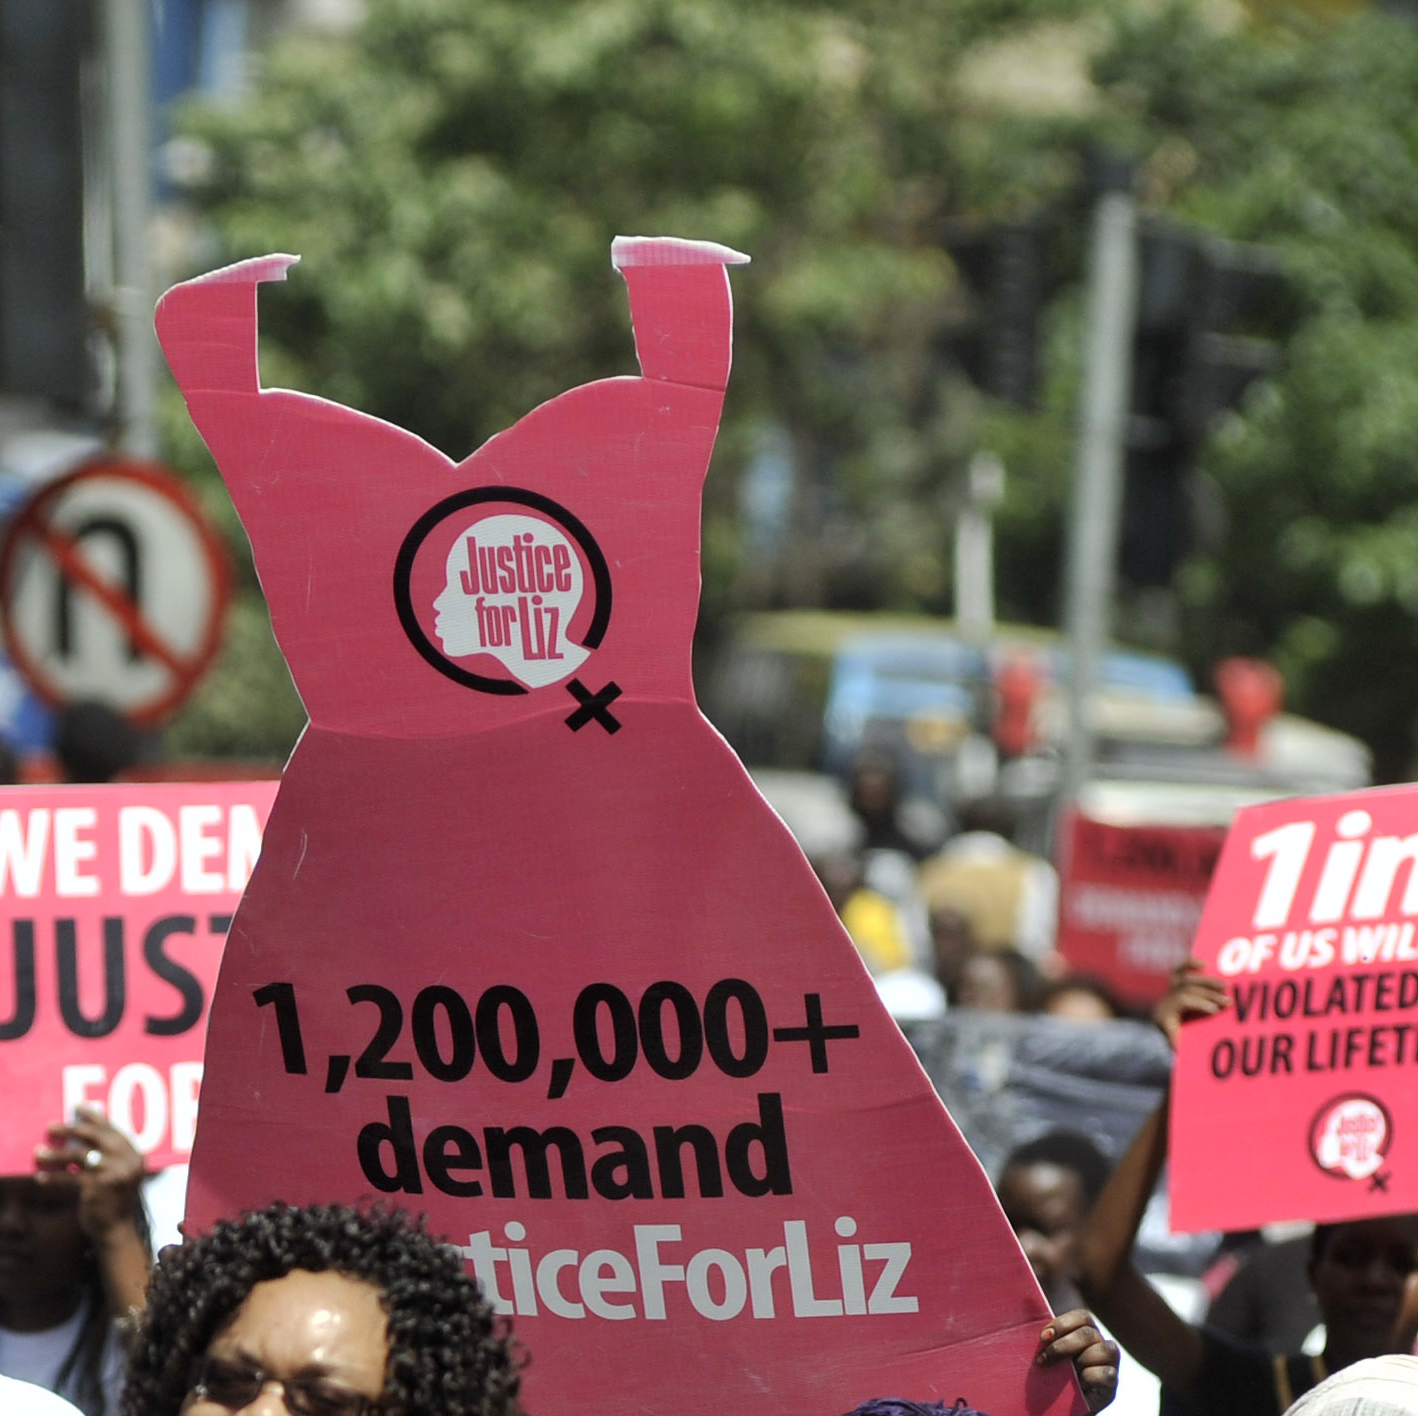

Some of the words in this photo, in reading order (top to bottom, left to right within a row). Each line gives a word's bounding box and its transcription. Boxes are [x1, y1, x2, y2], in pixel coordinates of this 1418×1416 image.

[460, 533, 572, 595] Justice
[475, 597, 517, 648] for
[517, 595, 564, 661] Liz
[1217, 934, 1277, 976] OF
[1277, 927, 1337, 970] US
[252, 978, 860, 1099] 1,200,000+
[1211, 1033, 1294, 1080] OUR
[357, 1092, 793, 1200] demand
[438, 1216, 919, 1321] ticeForLiz
